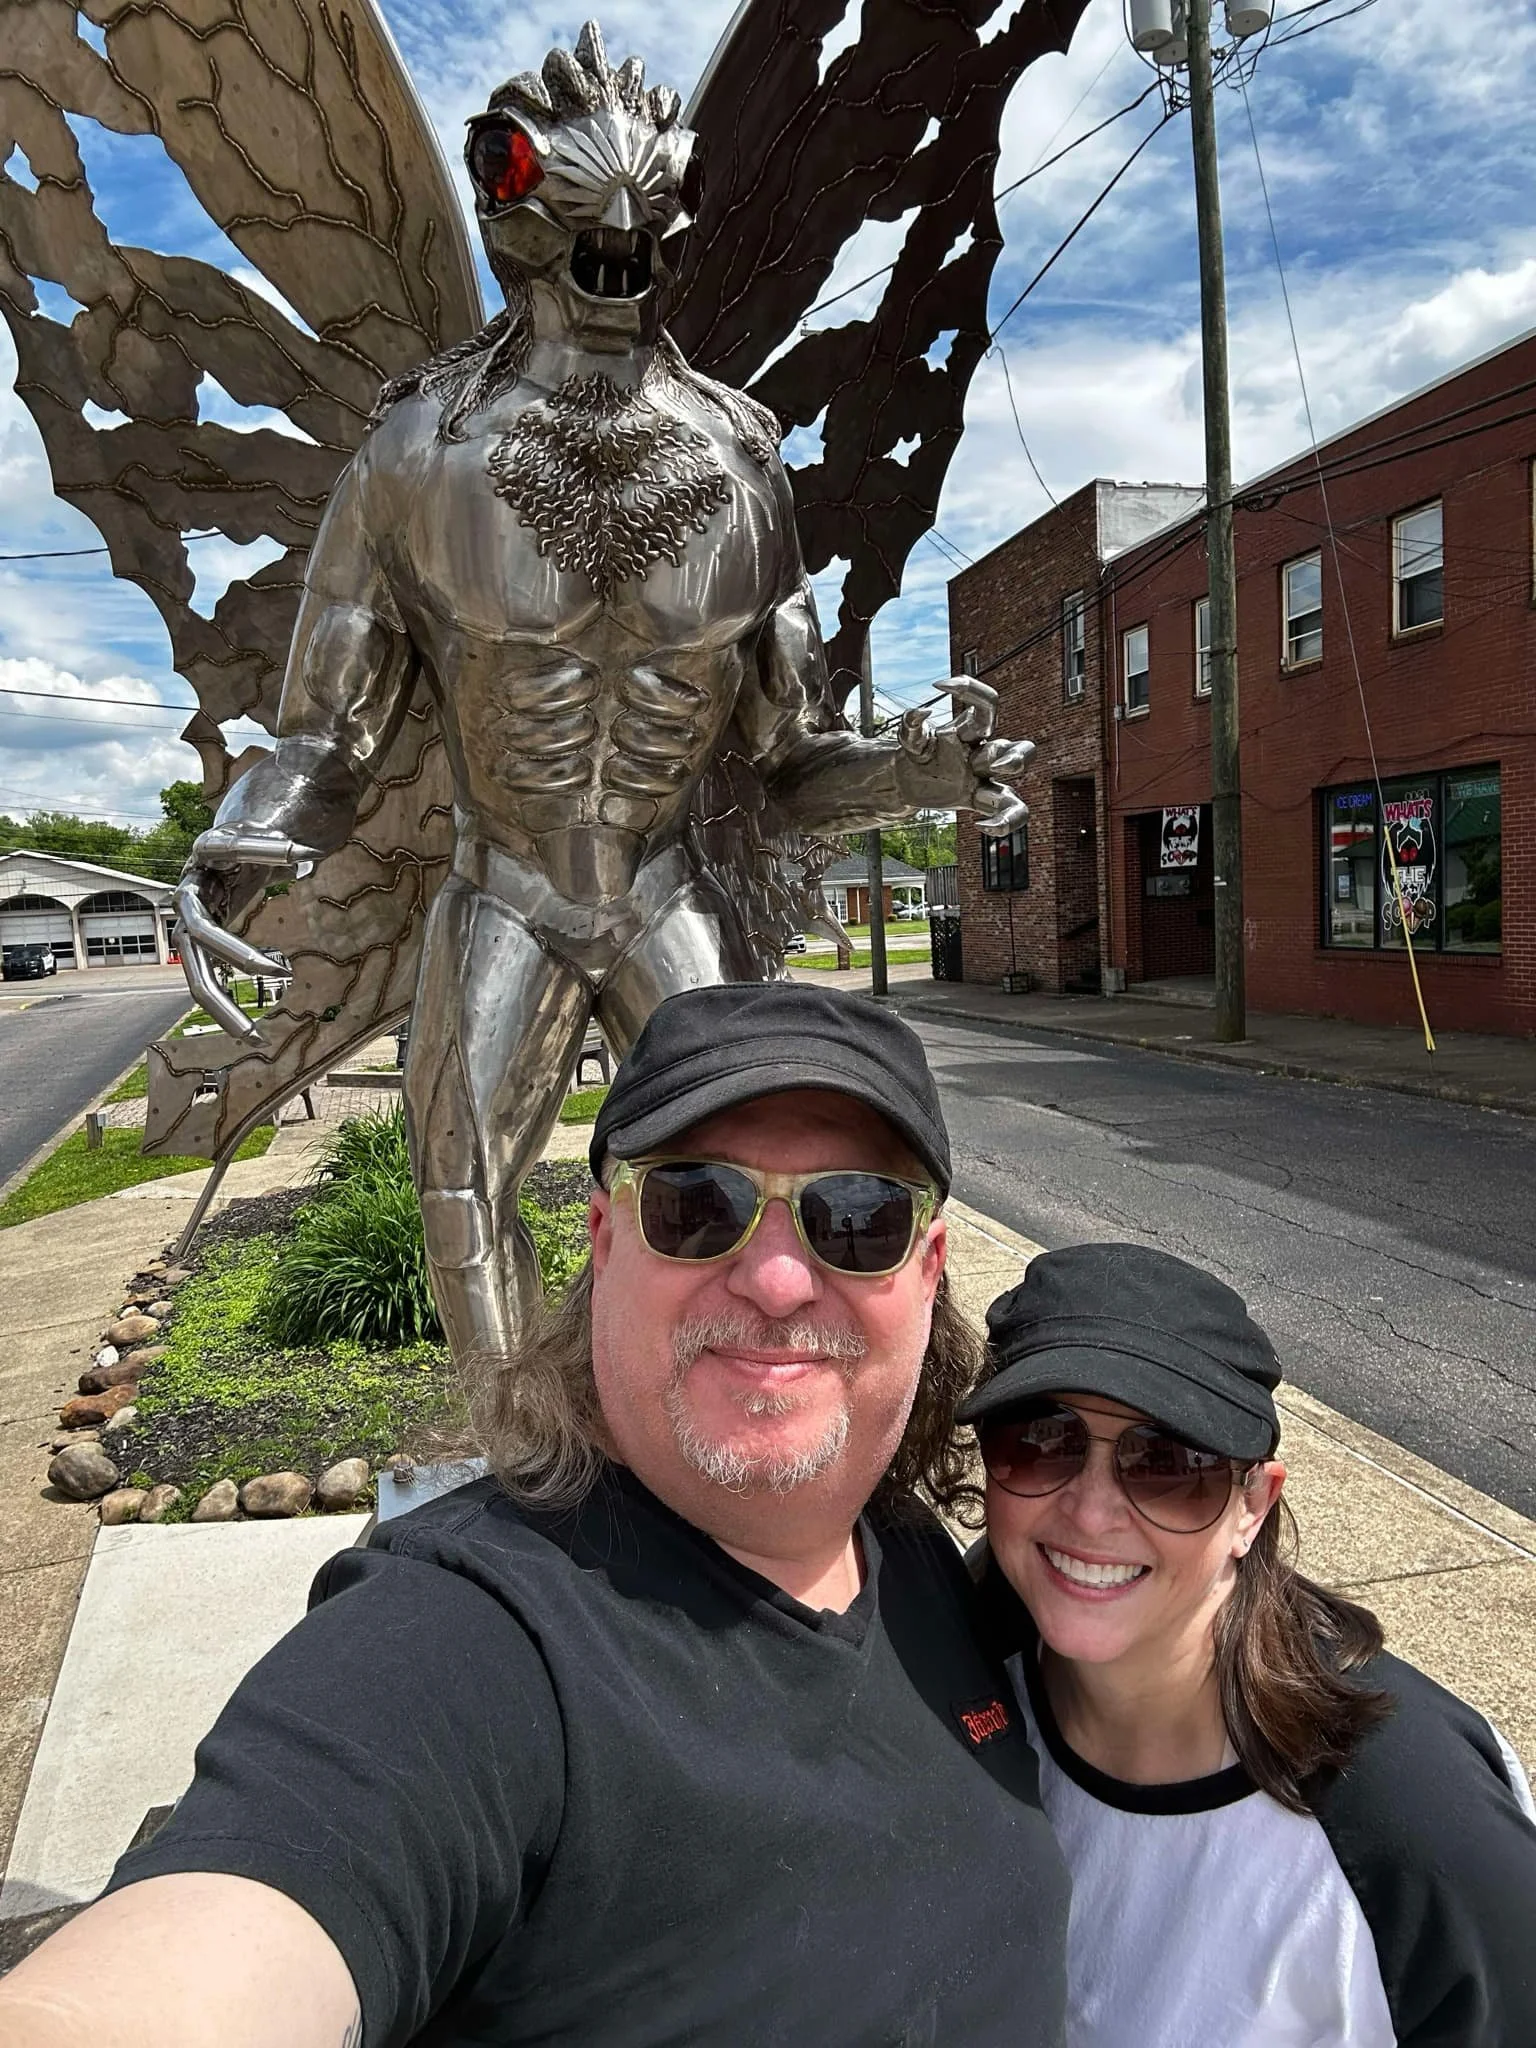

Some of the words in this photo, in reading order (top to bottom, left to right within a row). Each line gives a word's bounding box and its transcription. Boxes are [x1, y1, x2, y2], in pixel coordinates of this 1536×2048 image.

[1336, 796, 1348, 809] ICE
[1350, 792, 1373, 809] CREAM
[1166, 806, 1197, 817] WHAT'S
[1383, 799, 1433, 823] WHAT'S
[1391, 865, 1427, 884] THE
